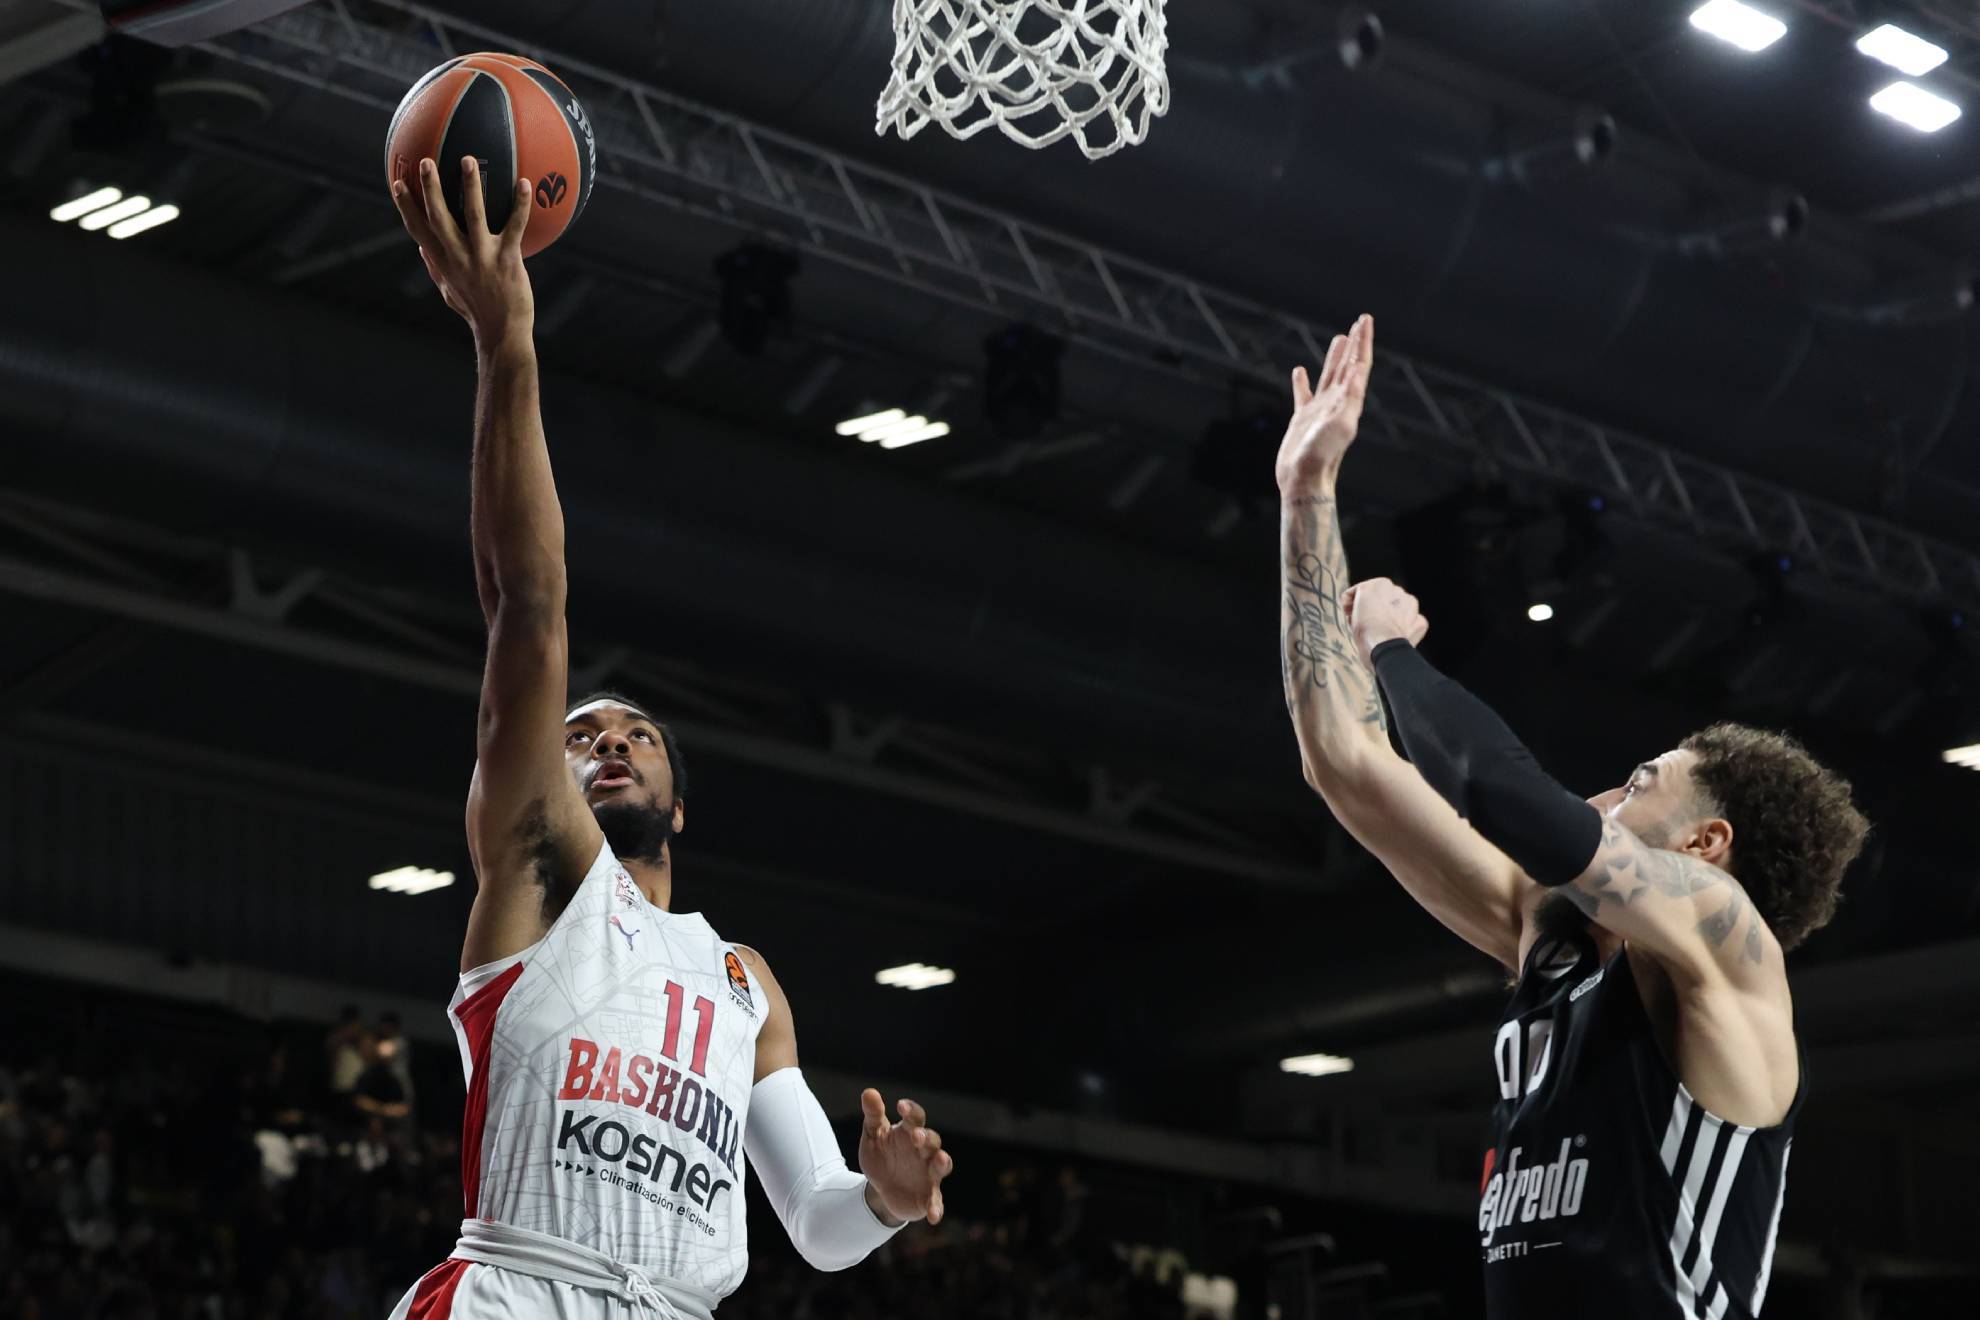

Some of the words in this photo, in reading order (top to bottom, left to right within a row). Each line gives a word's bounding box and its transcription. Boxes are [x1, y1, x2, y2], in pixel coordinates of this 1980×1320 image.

[660, 979, 715, 1078] 11
[558, 1037, 739, 1184] BASKONIA
[600, 1168, 674, 1212] Climatización
